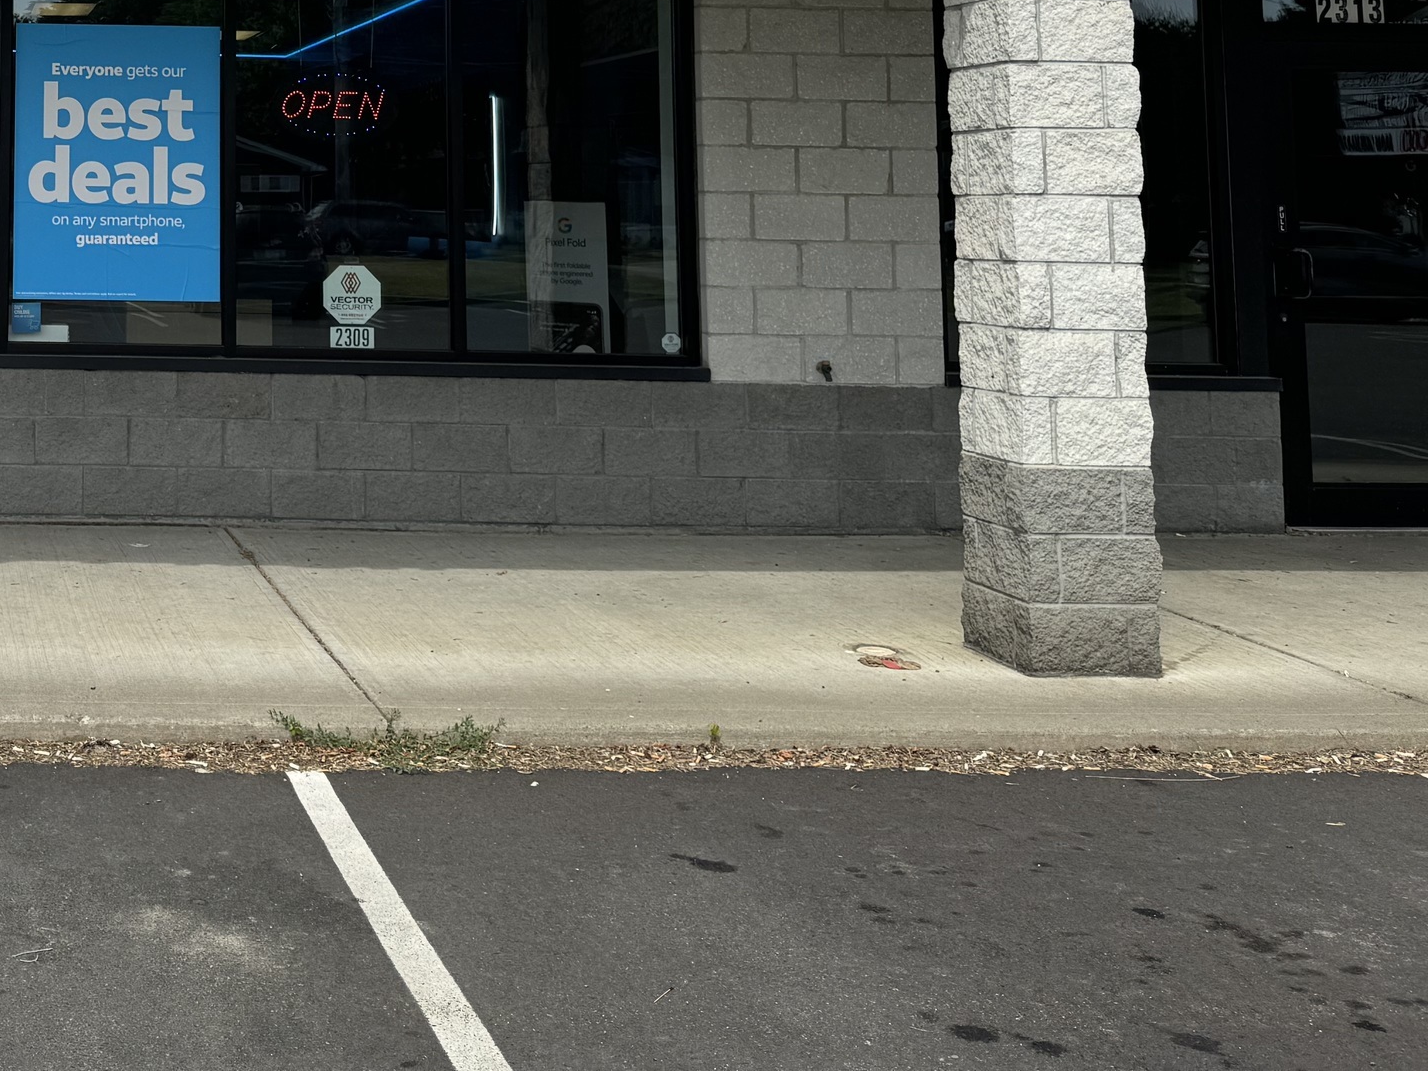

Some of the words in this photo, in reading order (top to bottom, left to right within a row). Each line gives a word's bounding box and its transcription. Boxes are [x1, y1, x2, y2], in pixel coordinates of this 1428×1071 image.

[51, 62, 123, 79] Everyone
[126, 65, 158, 80] gets
[162, 67, 186, 77] our
[43, 81, 195, 141] best
[281, 90, 385, 120] OPEN
[28, 144, 206, 206] deals
[51, 215, 69, 225] on
[72, 215, 97, 229] any
[99, 214, 185, 229] smartphone,
[76, 233, 159, 247] guaranteed
[566, 238, 586, 248] Fold
[330, 296, 374, 304] VECTOR
[335, 328, 370, 347] 2309
